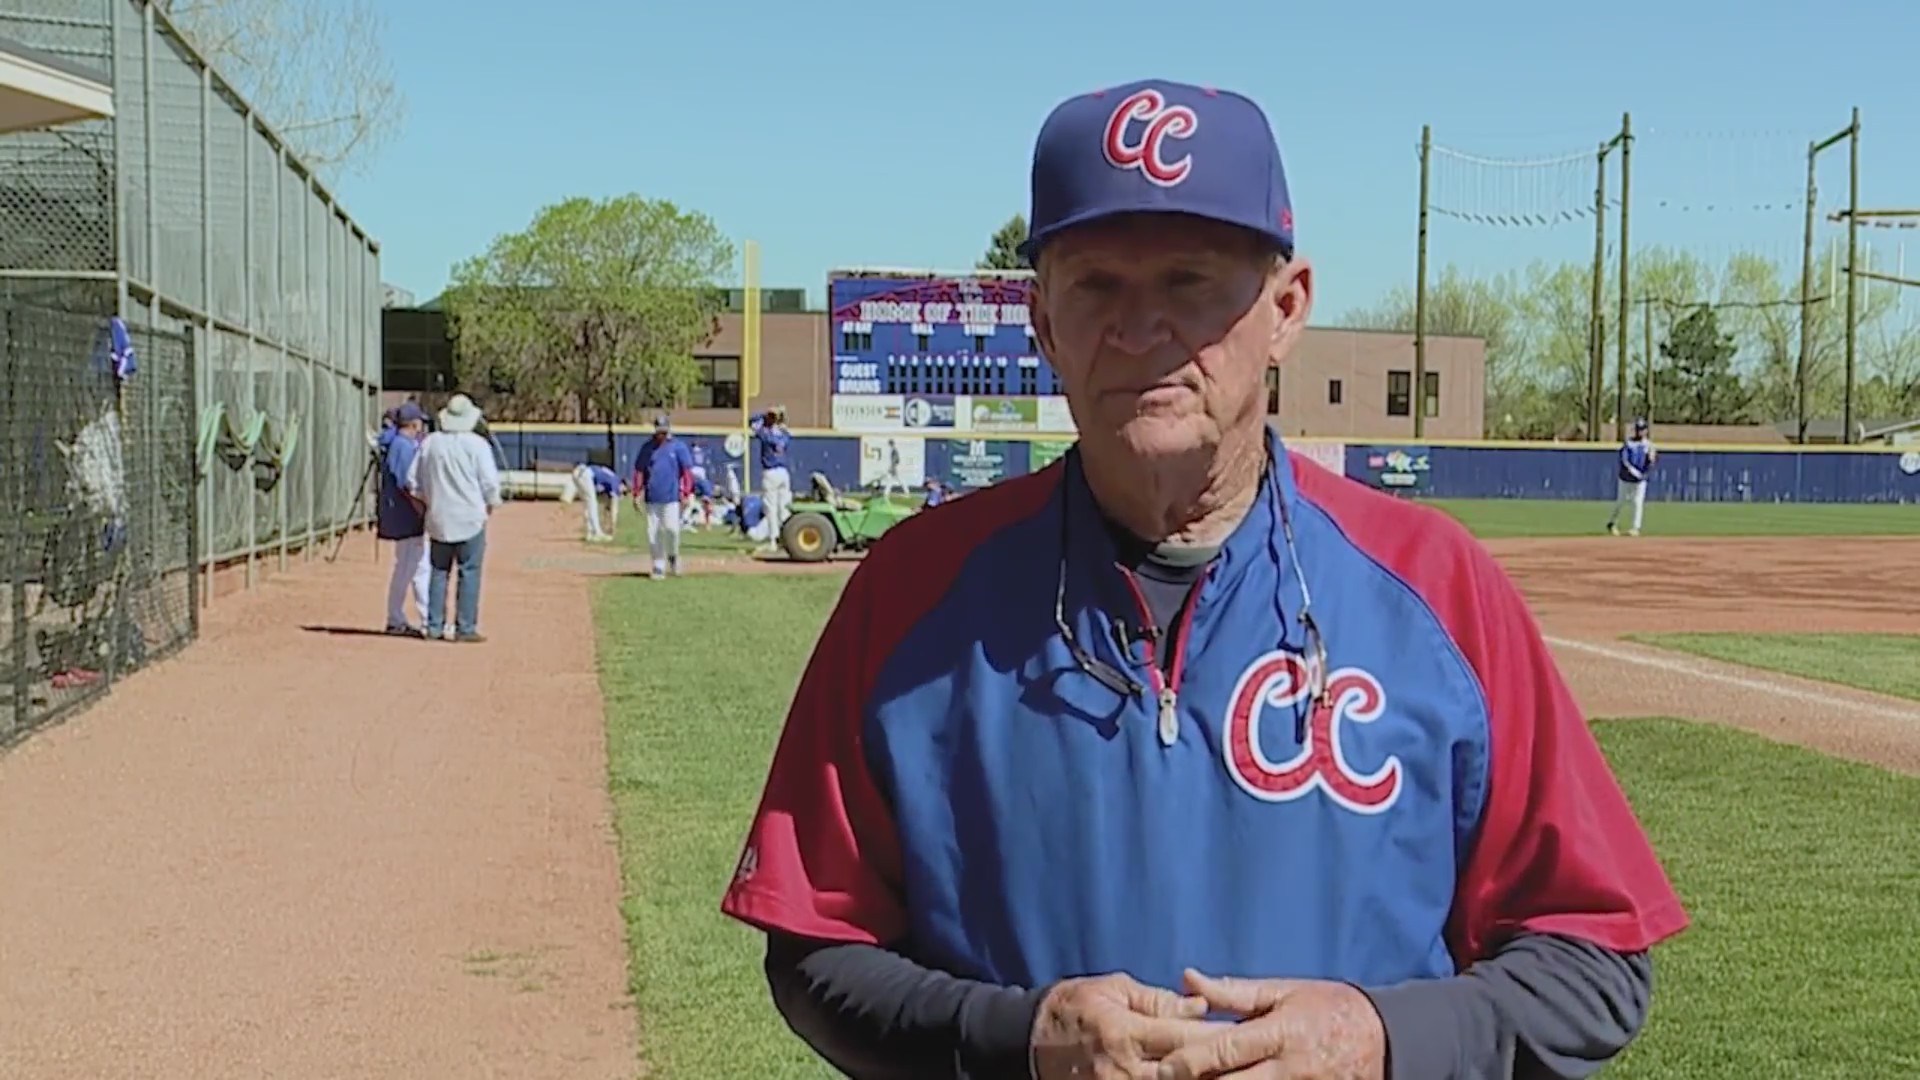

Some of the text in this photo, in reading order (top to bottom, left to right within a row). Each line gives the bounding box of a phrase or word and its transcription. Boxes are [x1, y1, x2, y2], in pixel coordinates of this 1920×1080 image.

[1103, 88, 1198, 187] CC
[925, 302, 951, 323] OF
[957, 303, 997, 324] THE
[841, 363, 877, 377] GUEST
[1223, 650, 1403, 815] CC
